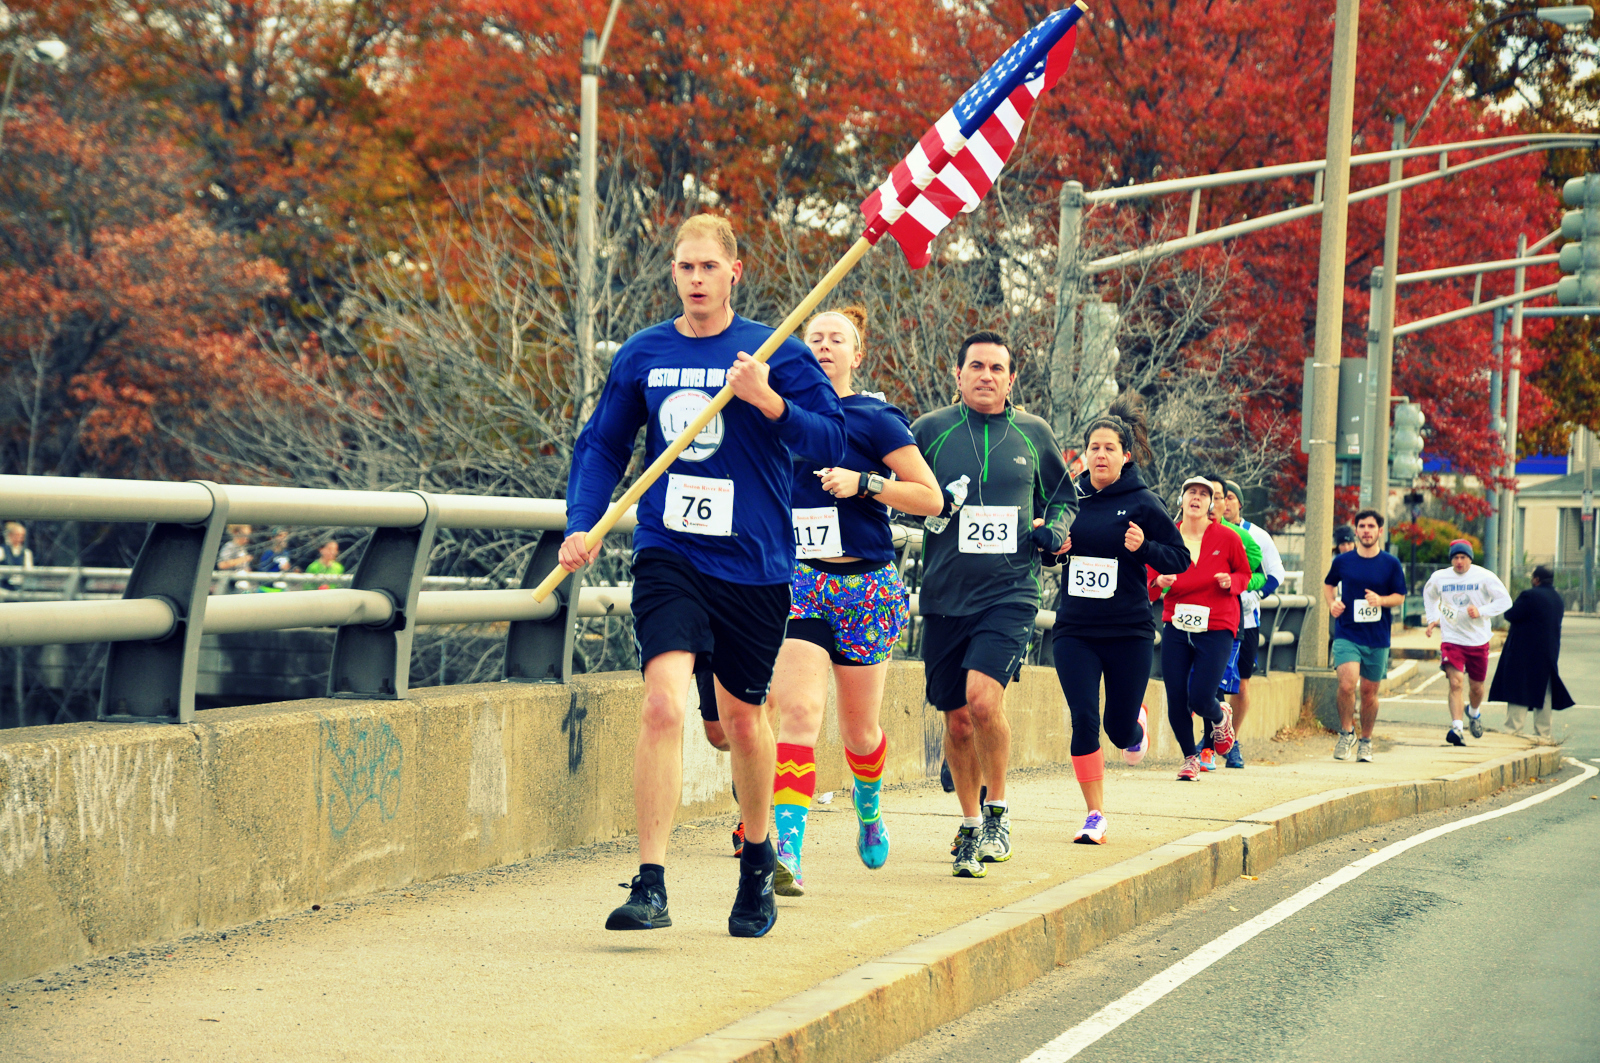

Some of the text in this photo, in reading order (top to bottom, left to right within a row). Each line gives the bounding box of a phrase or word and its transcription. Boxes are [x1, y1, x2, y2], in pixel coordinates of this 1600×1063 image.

[680, 368, 706, 387] RIVER
[706, 368, 726, 387] RUN
[682, 495, 712, 520] 76
[793, 525, 829, 546] 117
[967, 522, 1008, 541] 263
[1075, 570, 1110, 588] 530
[1177, 613, 1202, 627] 328
[1357, 606, 1378, 617] 469
